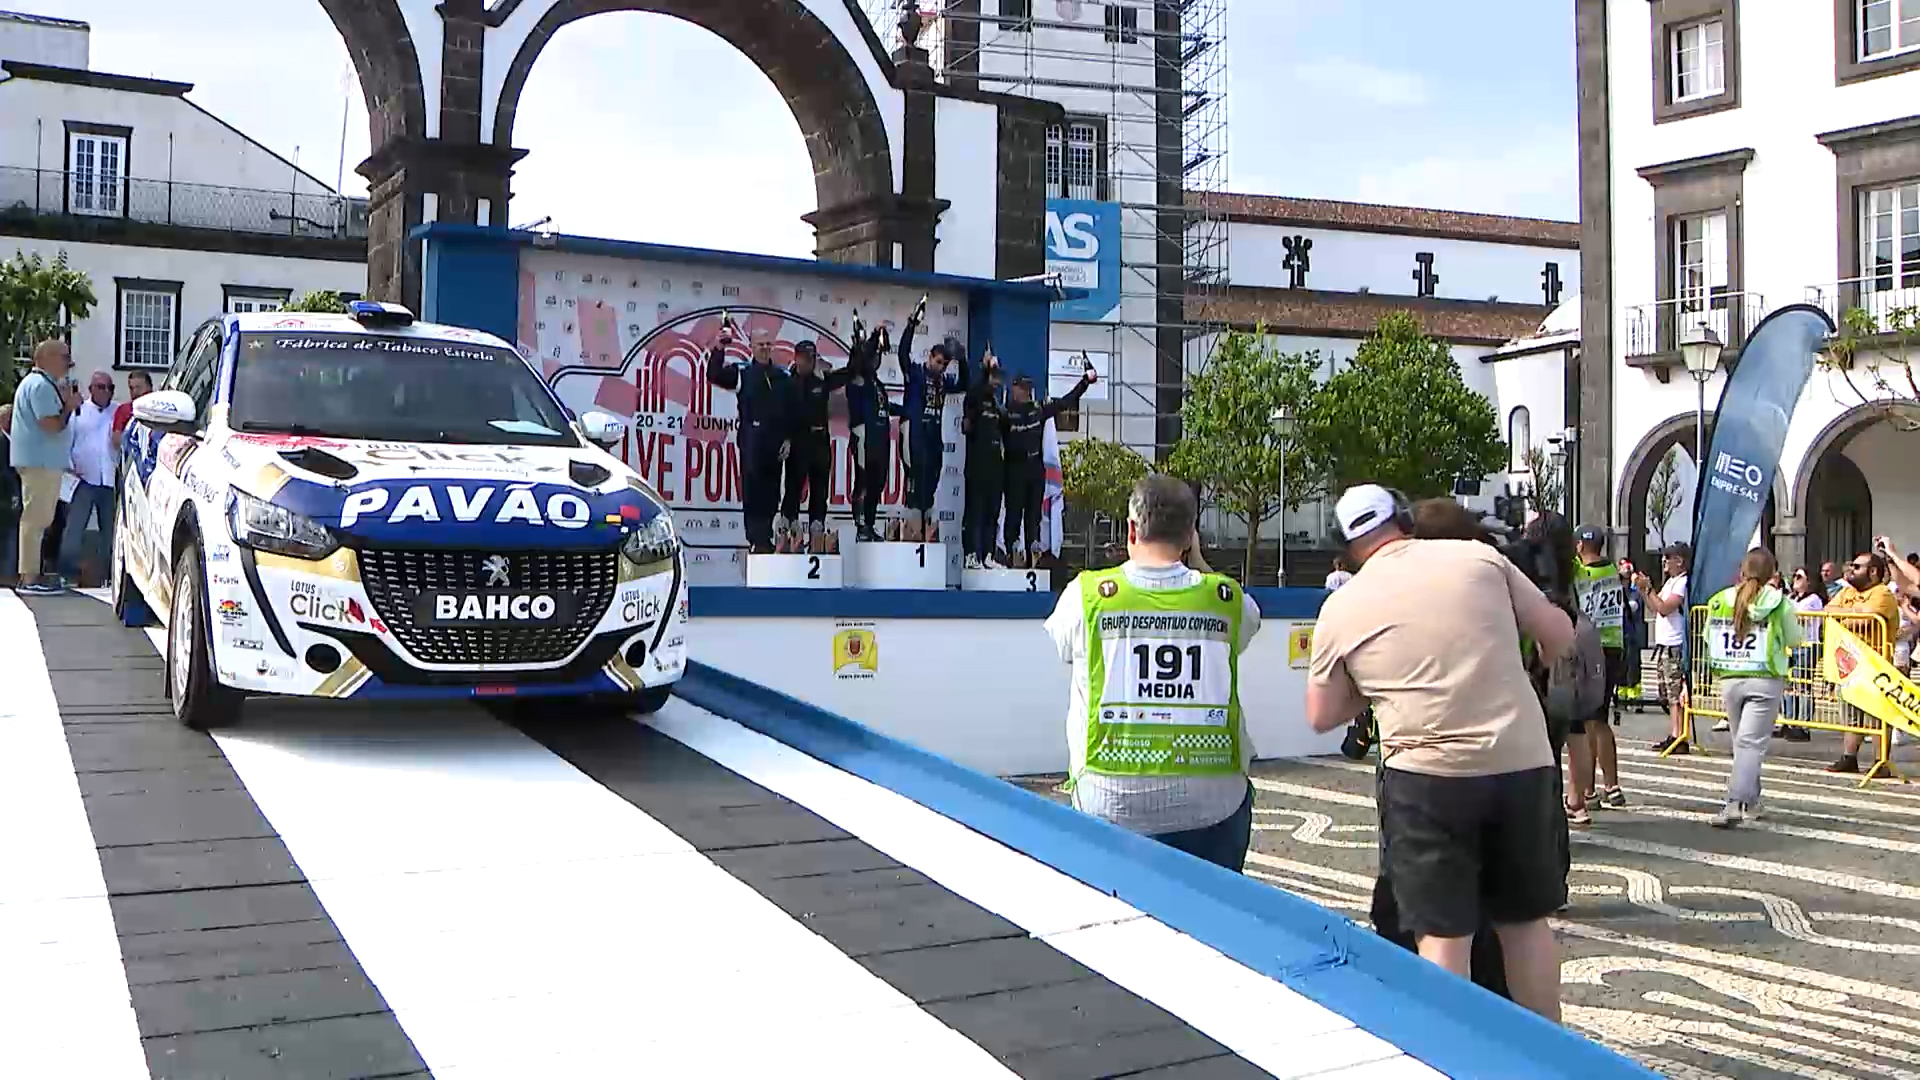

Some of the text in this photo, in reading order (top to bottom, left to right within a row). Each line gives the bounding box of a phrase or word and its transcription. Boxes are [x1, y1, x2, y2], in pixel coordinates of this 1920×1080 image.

[353, 339, 373, 350] de
[377, 340, 438, 354] Tabaco
[636, 414, 654, 427] 20
[667, 416, 683, 429] 21
[1714, 451, 1763, 487] MEO
[339, 482, 591, 530] PAVÃO
[807, 555, 820, 580] 2
[915, 544, 926, 568] 1
[291, 579, 316, 594] LOTUS
[1025, 571, 1037, 592] 3
[290, 593, 353, 623] Click
[436, 595, 556, 620] BAHCO
[623, 595, 661, 622] Click
[1101, 616, 1130, 631] GRUPO
[1132, 616, 1186, 630] DESPORTIVO
[1722, 632, 1757, 650] 182
[1133, 644, 1201, 681] 191
[1138, 683, 1195, 699] MEDIA
